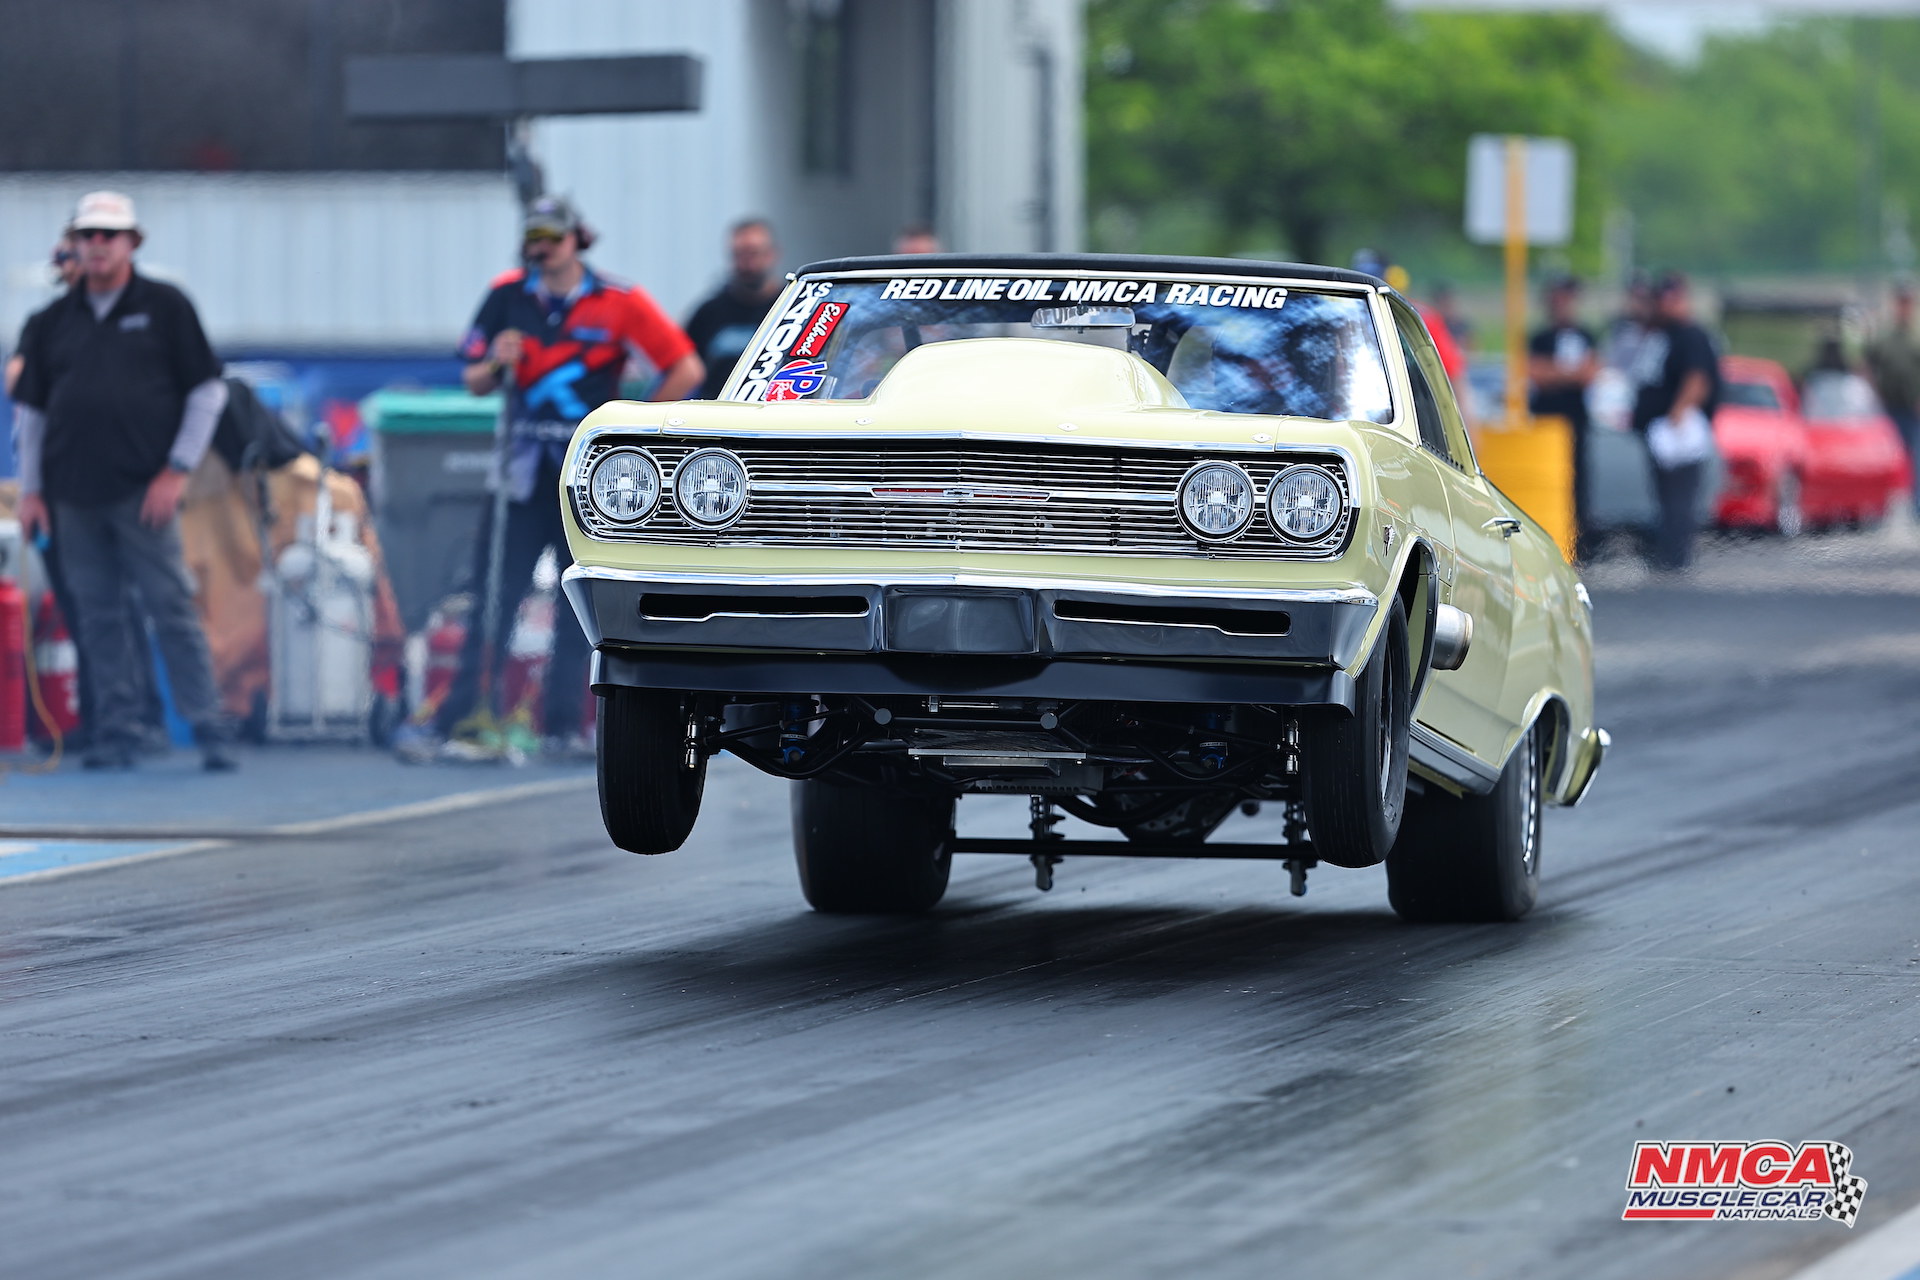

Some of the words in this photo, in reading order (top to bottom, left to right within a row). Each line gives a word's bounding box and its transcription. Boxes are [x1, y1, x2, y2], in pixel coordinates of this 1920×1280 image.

[798, 282, 834, 298] XS
[879, 278, 944, 300] RED
[938, 278, 1009, 300] LINE
[1006, 278, 1054, 301] OIL
[1058, 279, 1159, 304] NMCA
[1163, 282, 1289, 310] RACING
[796, 302, 841, 356] Edelbrock
[771, 361, 827, 395] VP
